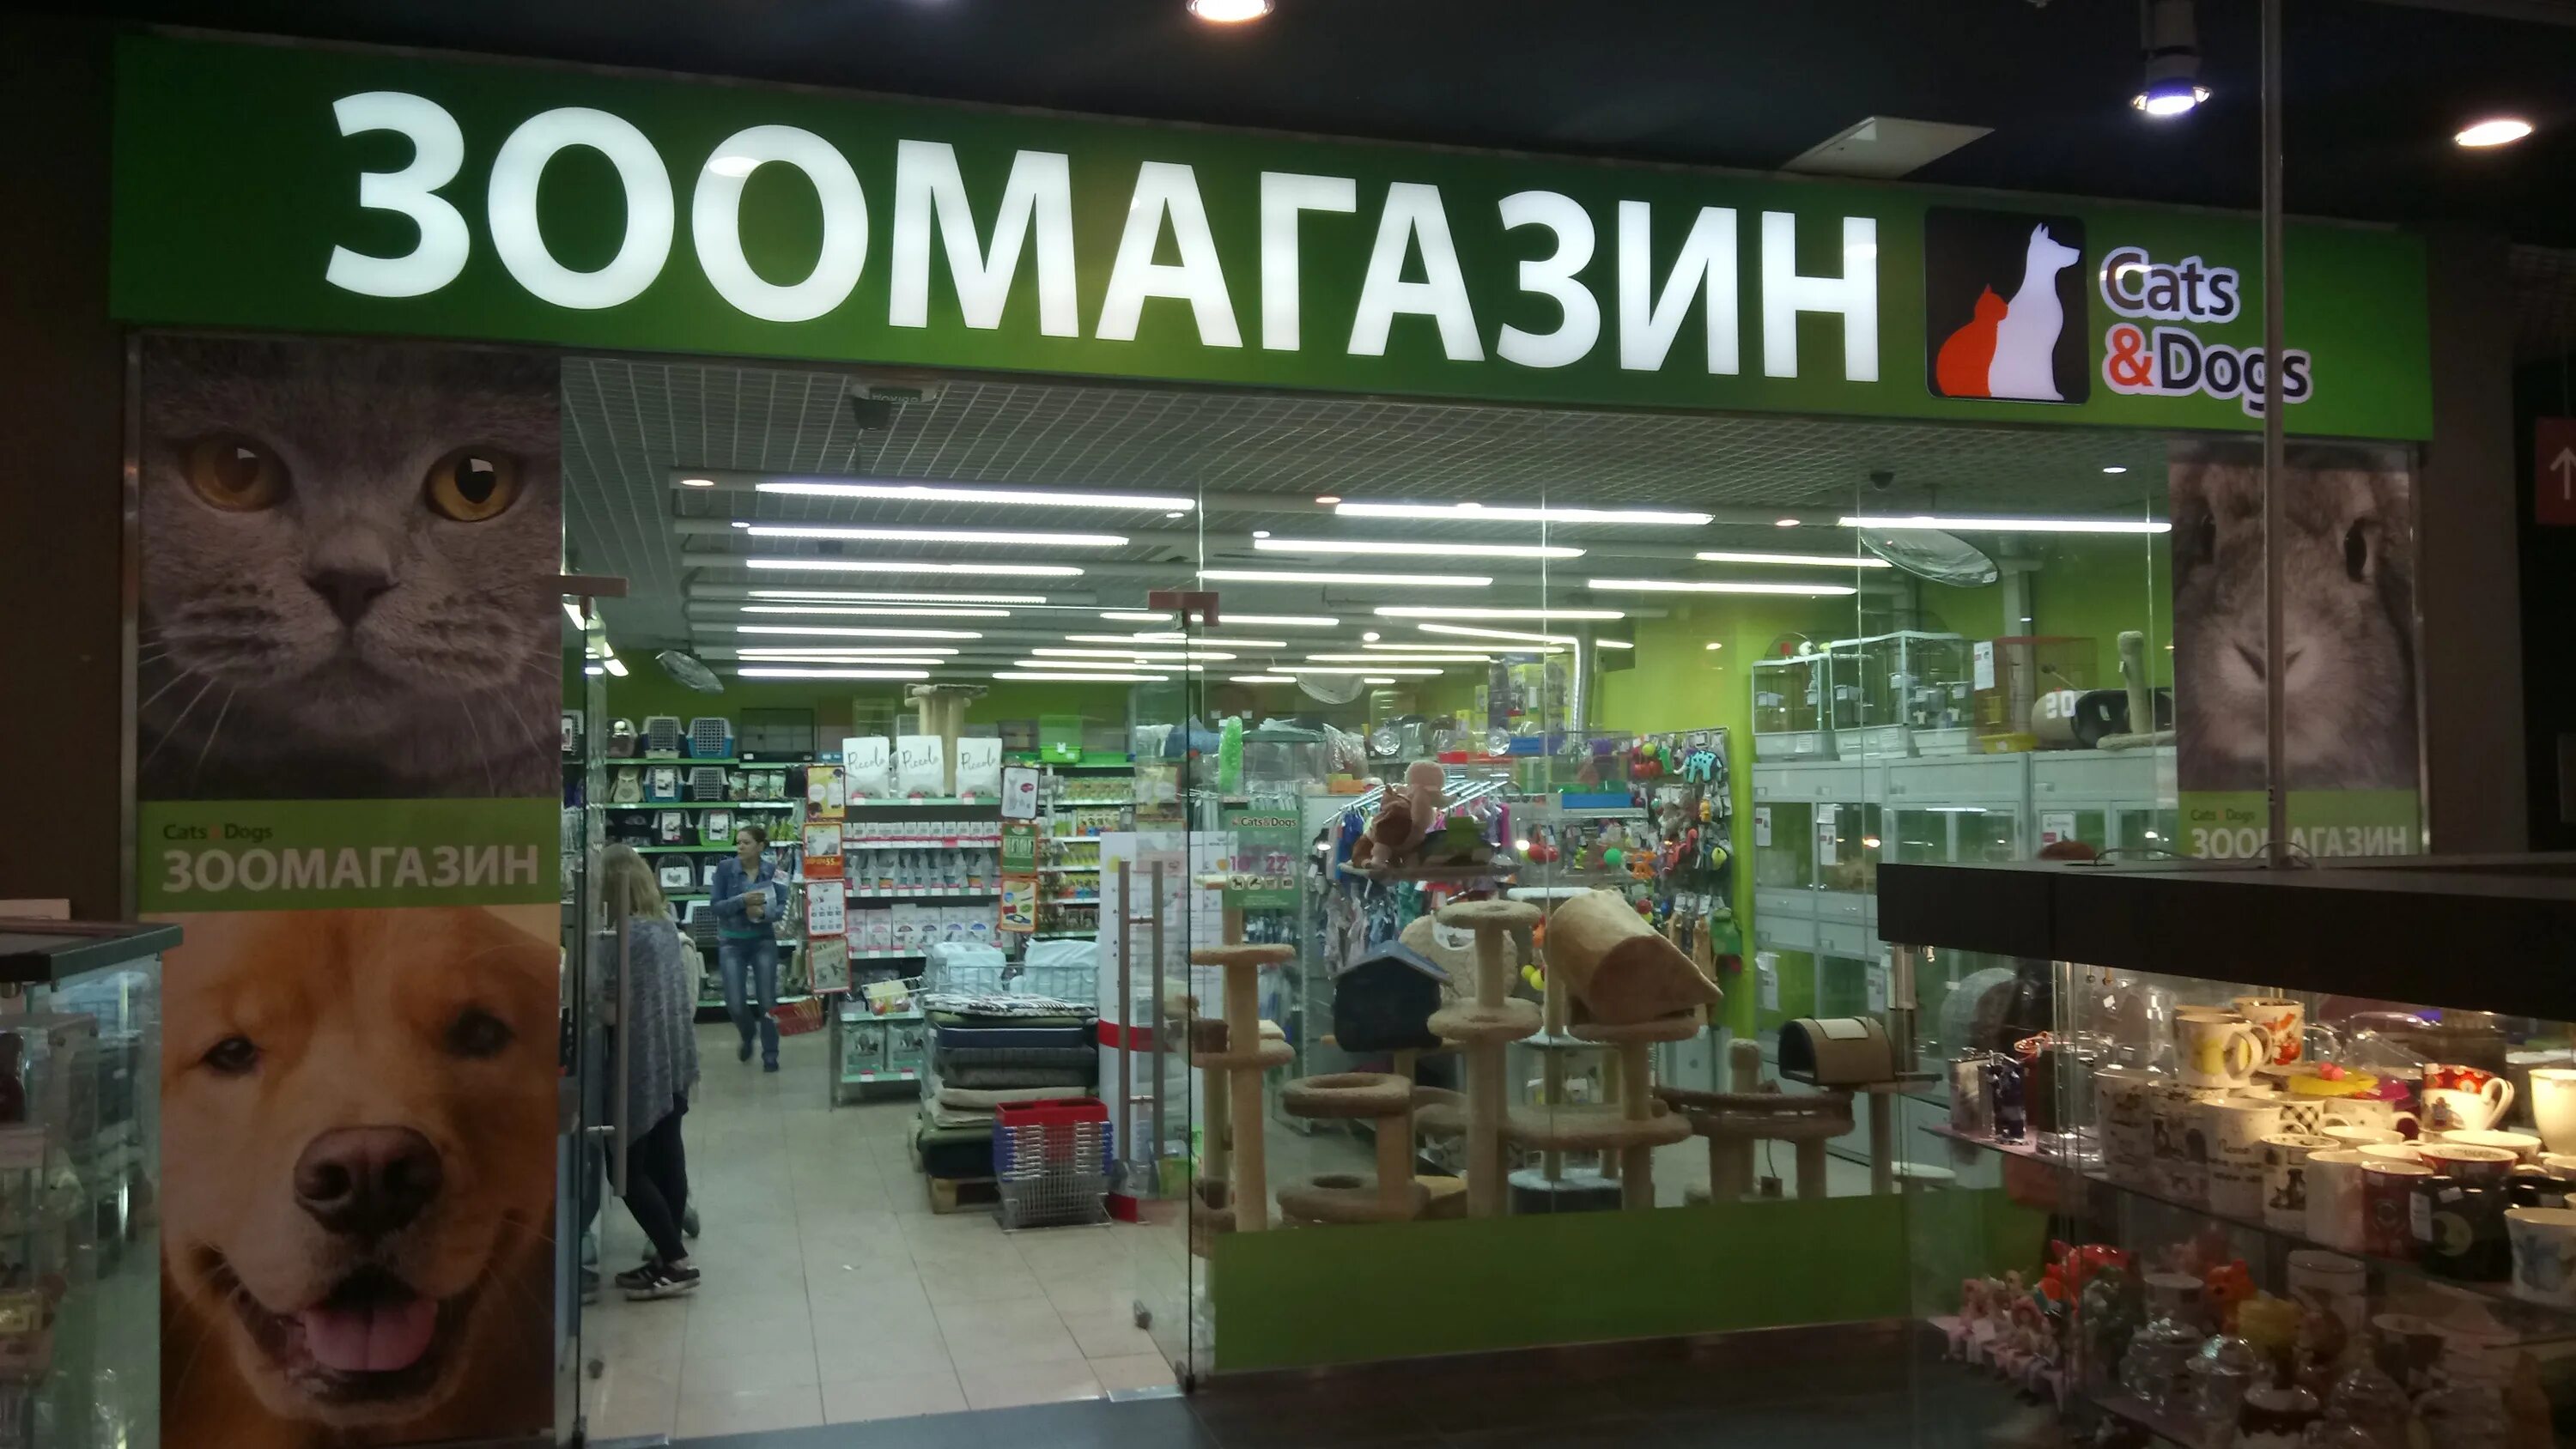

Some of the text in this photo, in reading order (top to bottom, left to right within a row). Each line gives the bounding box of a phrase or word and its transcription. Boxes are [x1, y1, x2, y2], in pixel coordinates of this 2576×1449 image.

[325, 90, 1879, 382] ЗООМАГАЗИН
[2102, 249, 2237, 319] Cats
[161, 844, 539, 894] ЗООМАГАЗИН
